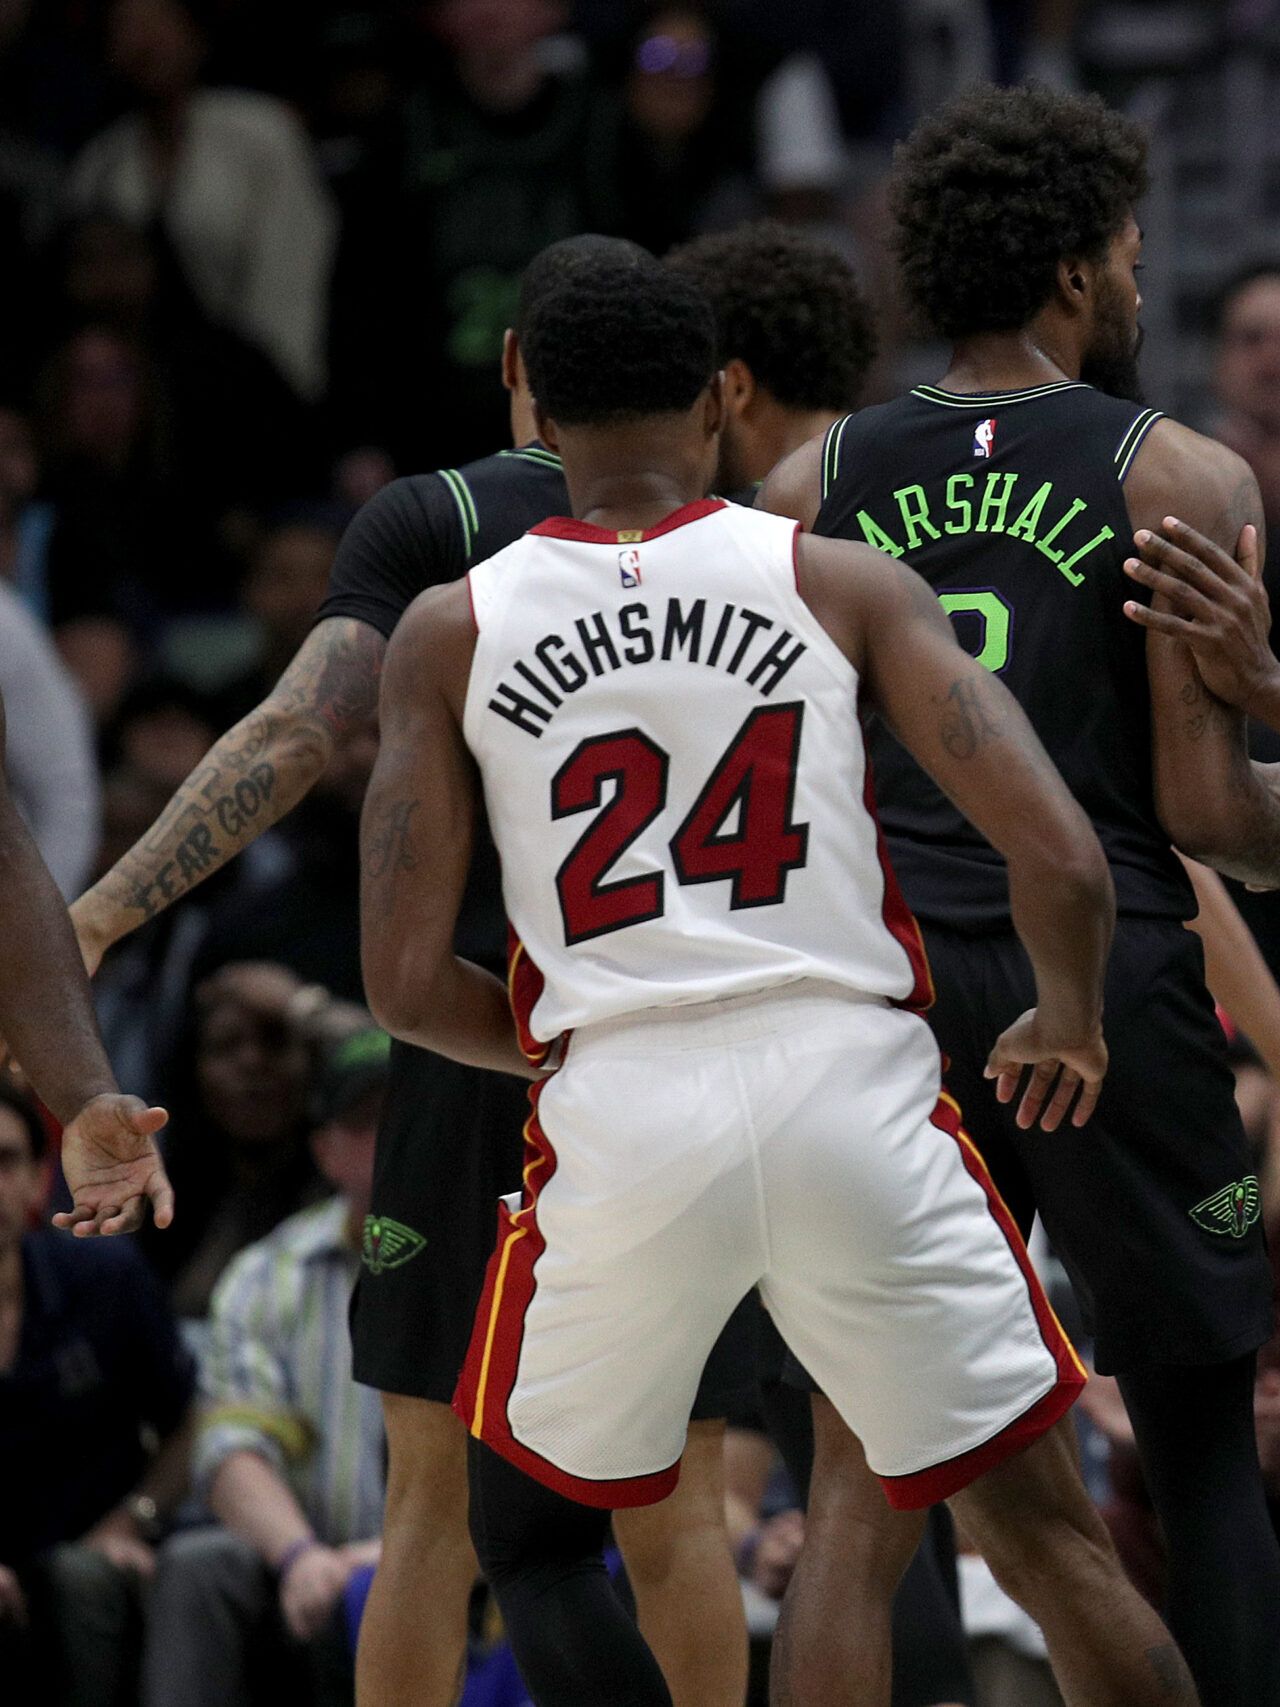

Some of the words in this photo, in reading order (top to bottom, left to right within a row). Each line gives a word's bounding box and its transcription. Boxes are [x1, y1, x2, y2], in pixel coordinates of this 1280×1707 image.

[856, 472, 1115, 587] ARSHALL
[487, 597, 808, 739] HIGHSMITH
[134, 823, 221, 915] FEAR
[215, 762, 275, 837] GOD
[551, 699, 810, 948] 24
